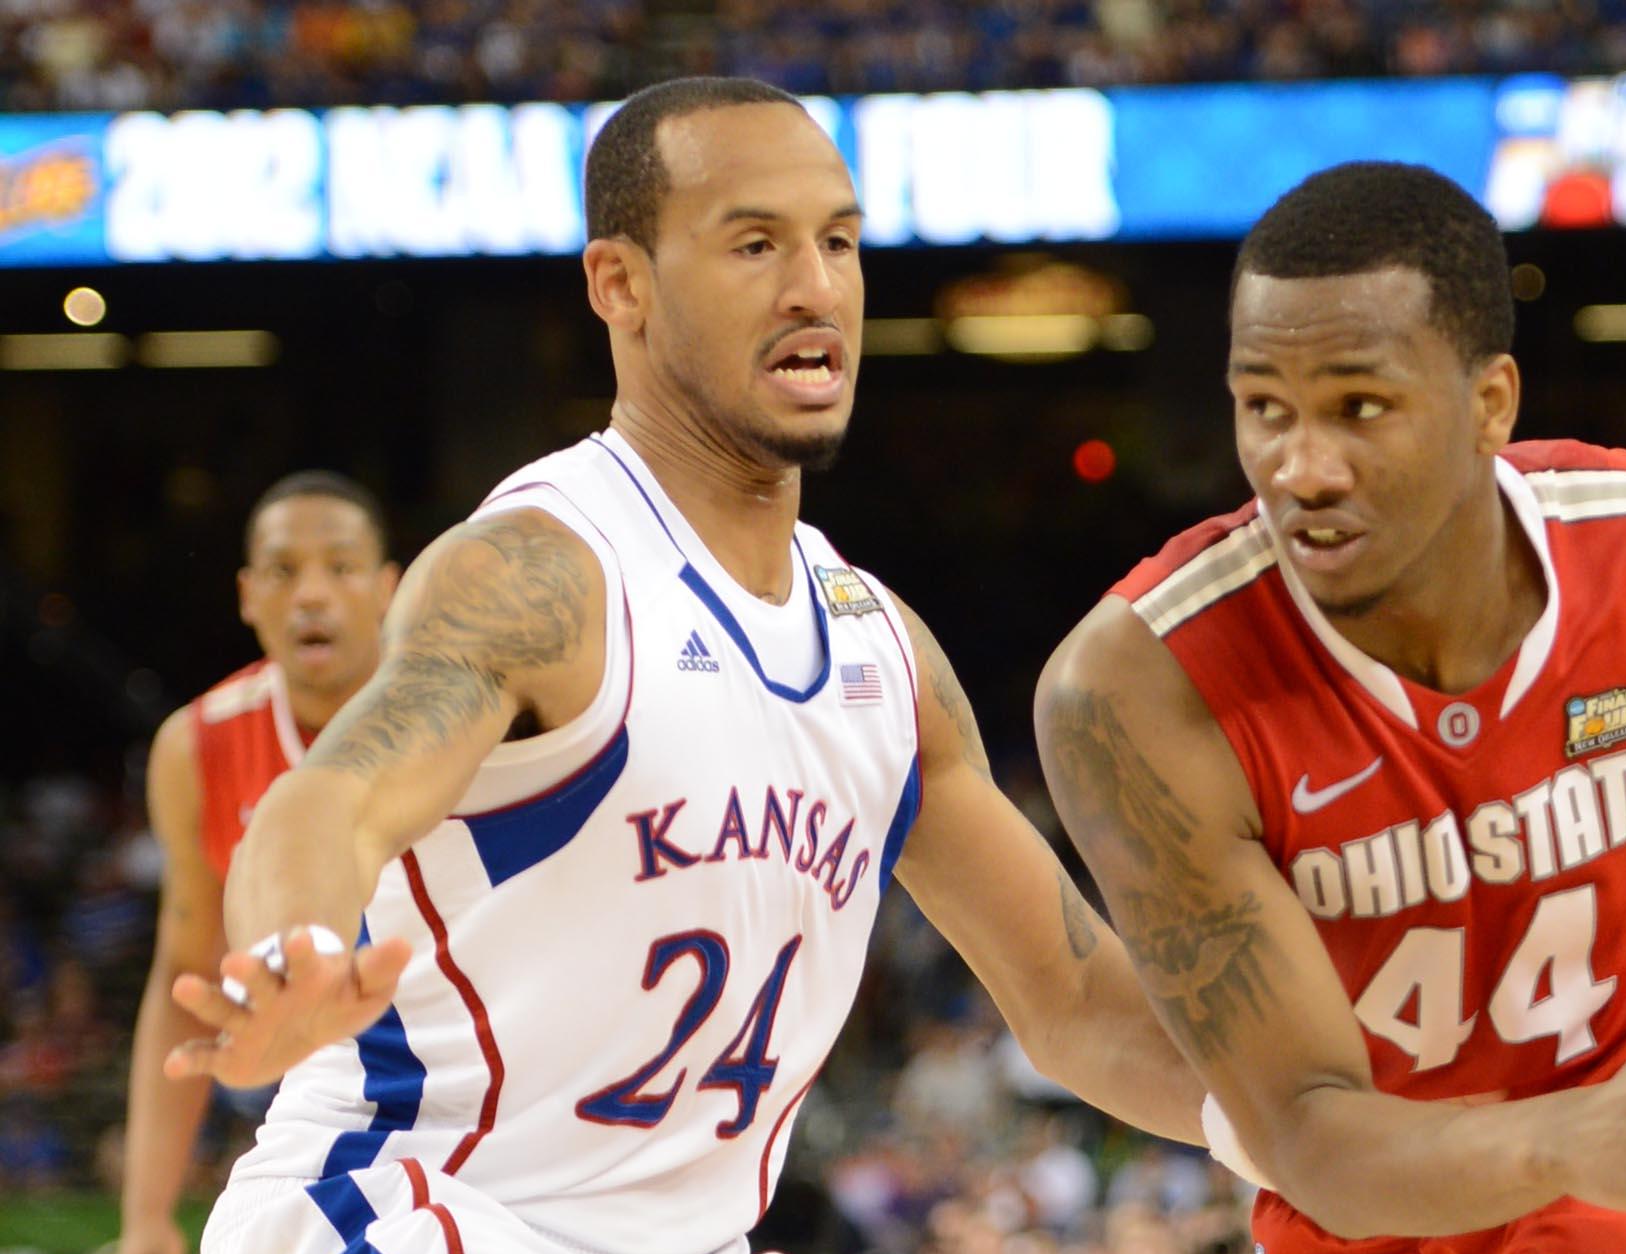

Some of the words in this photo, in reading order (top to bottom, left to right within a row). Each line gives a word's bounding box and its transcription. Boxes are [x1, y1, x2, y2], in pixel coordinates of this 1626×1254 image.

[677, 655, 720, 673] adidas
[626, 785, 870, 911] KANSAS
[1290, 808, 1470, 921] OHIO
[575, 928, 802, 1140] 24
[1353, 884, 1617, 1074] 44
